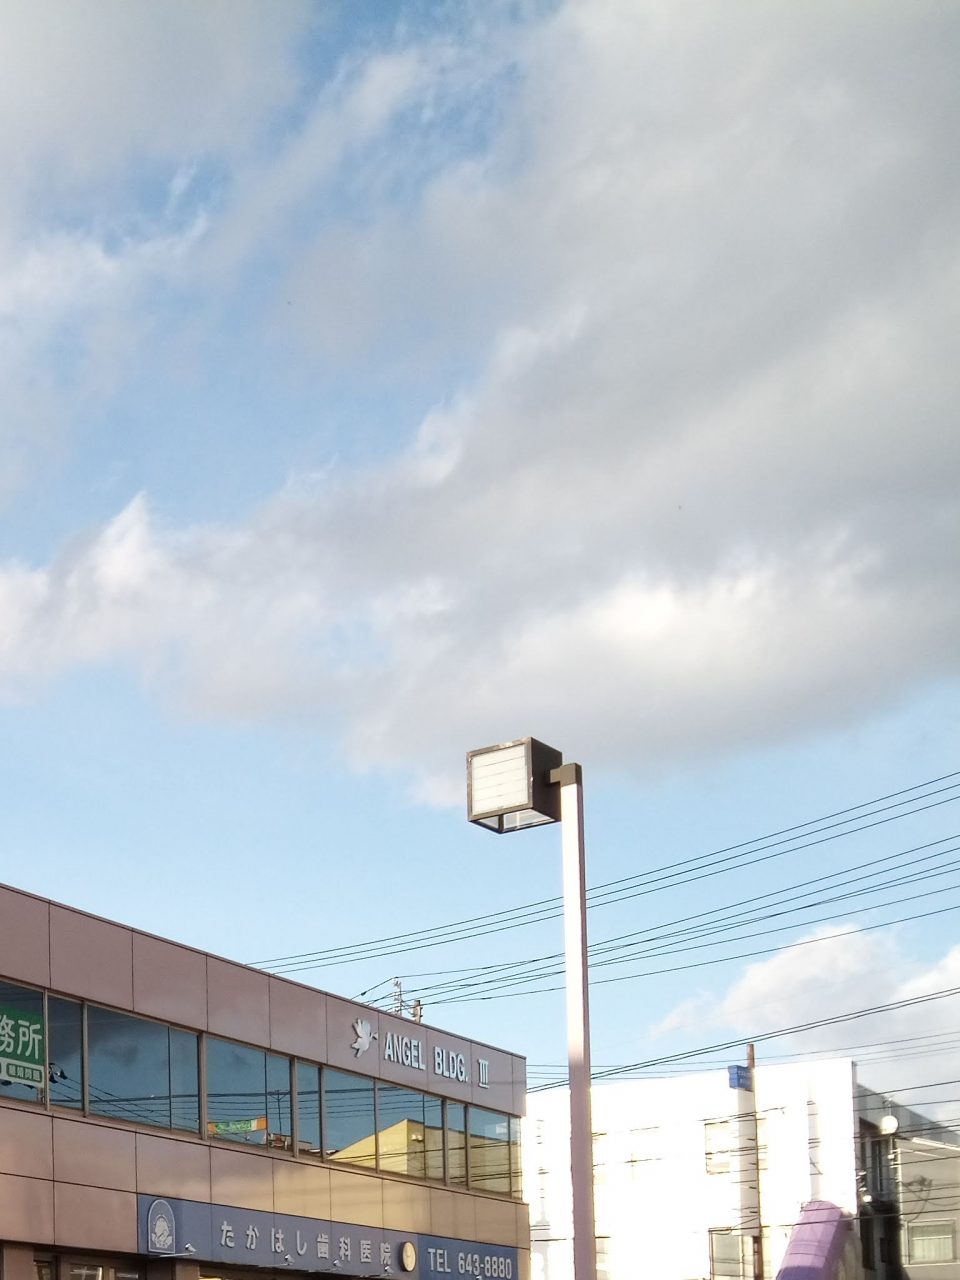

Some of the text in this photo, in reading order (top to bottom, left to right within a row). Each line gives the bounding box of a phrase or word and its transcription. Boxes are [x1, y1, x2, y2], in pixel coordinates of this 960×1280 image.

[384, 1032, 426, 1071] ANGEL
[434, 1046, 468, 1082] BLDG.
[220, 1220, 392, 1264] たかはし歯科医院
[427, 1247, 512, 1279] TEL 643-8880
